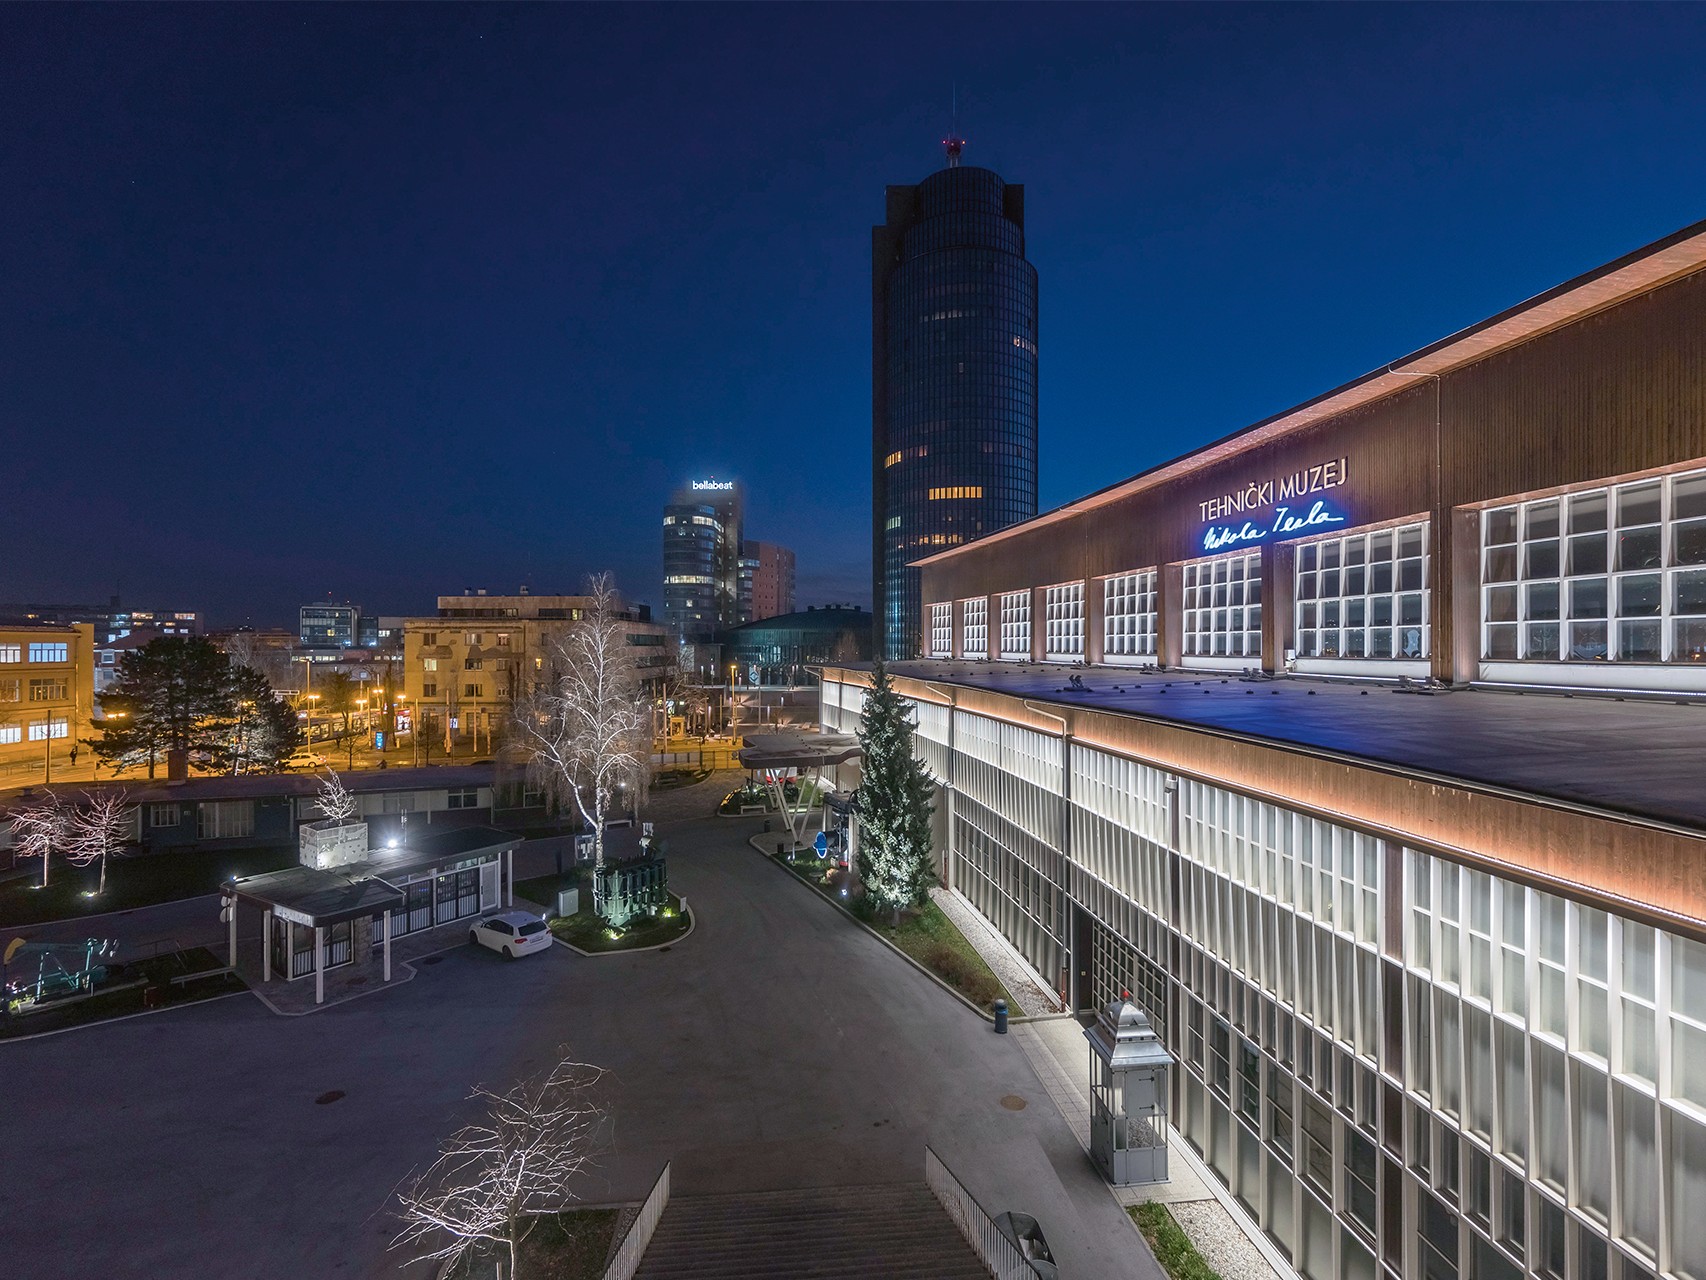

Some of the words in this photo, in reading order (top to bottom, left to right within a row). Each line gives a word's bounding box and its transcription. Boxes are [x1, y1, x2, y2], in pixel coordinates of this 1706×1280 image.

[692, 480, 733, 490] bellabeat
[1199, 481, 1274, 522] TEHNIČKI
[1279, 457, 1347, 501] MUZEJ
[1203, 522, 1267, 550] Nikola
[1272, 500, 1344, 532] Tesla
